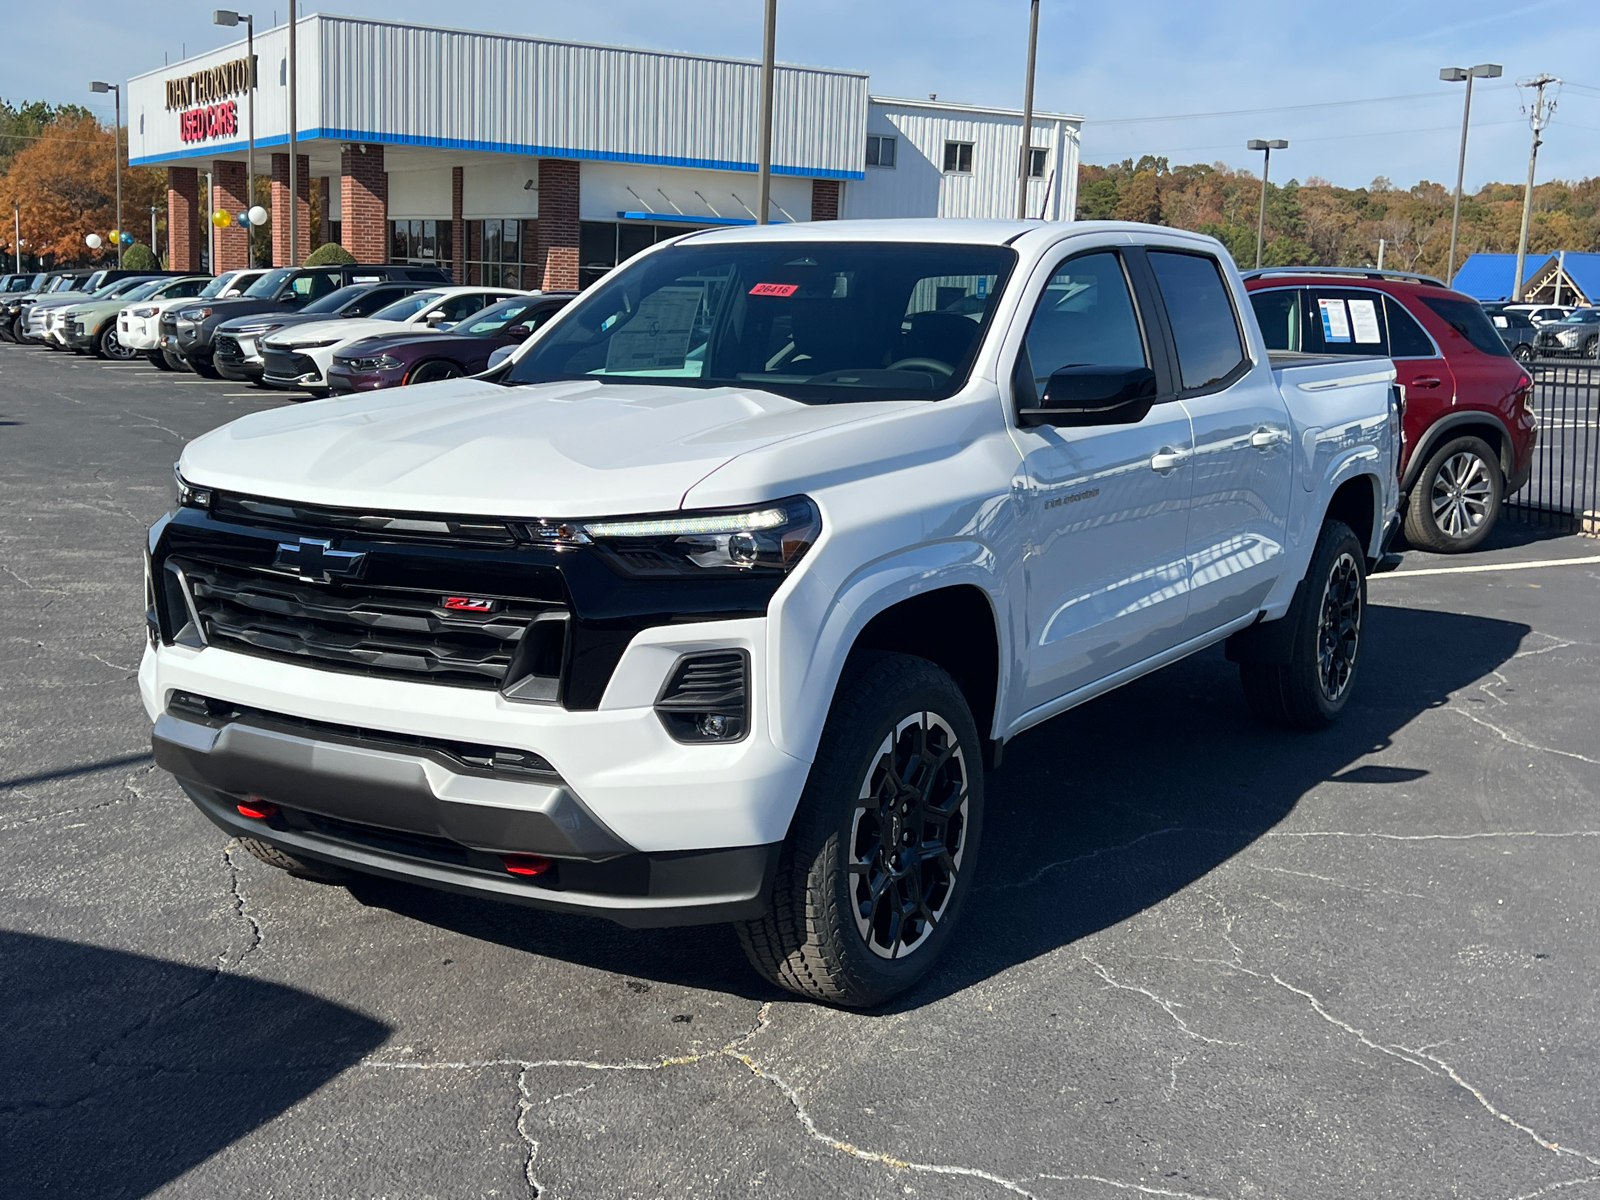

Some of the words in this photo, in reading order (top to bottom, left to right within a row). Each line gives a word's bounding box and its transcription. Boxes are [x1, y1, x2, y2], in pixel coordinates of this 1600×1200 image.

[164, 76, 194, 112] JOHN
[180, 108, 206, 144] USED
[206, 100, 238, 139] CARS
[756, 285, 790, 294] 26416
[444, 597, 493, 611] Z71
